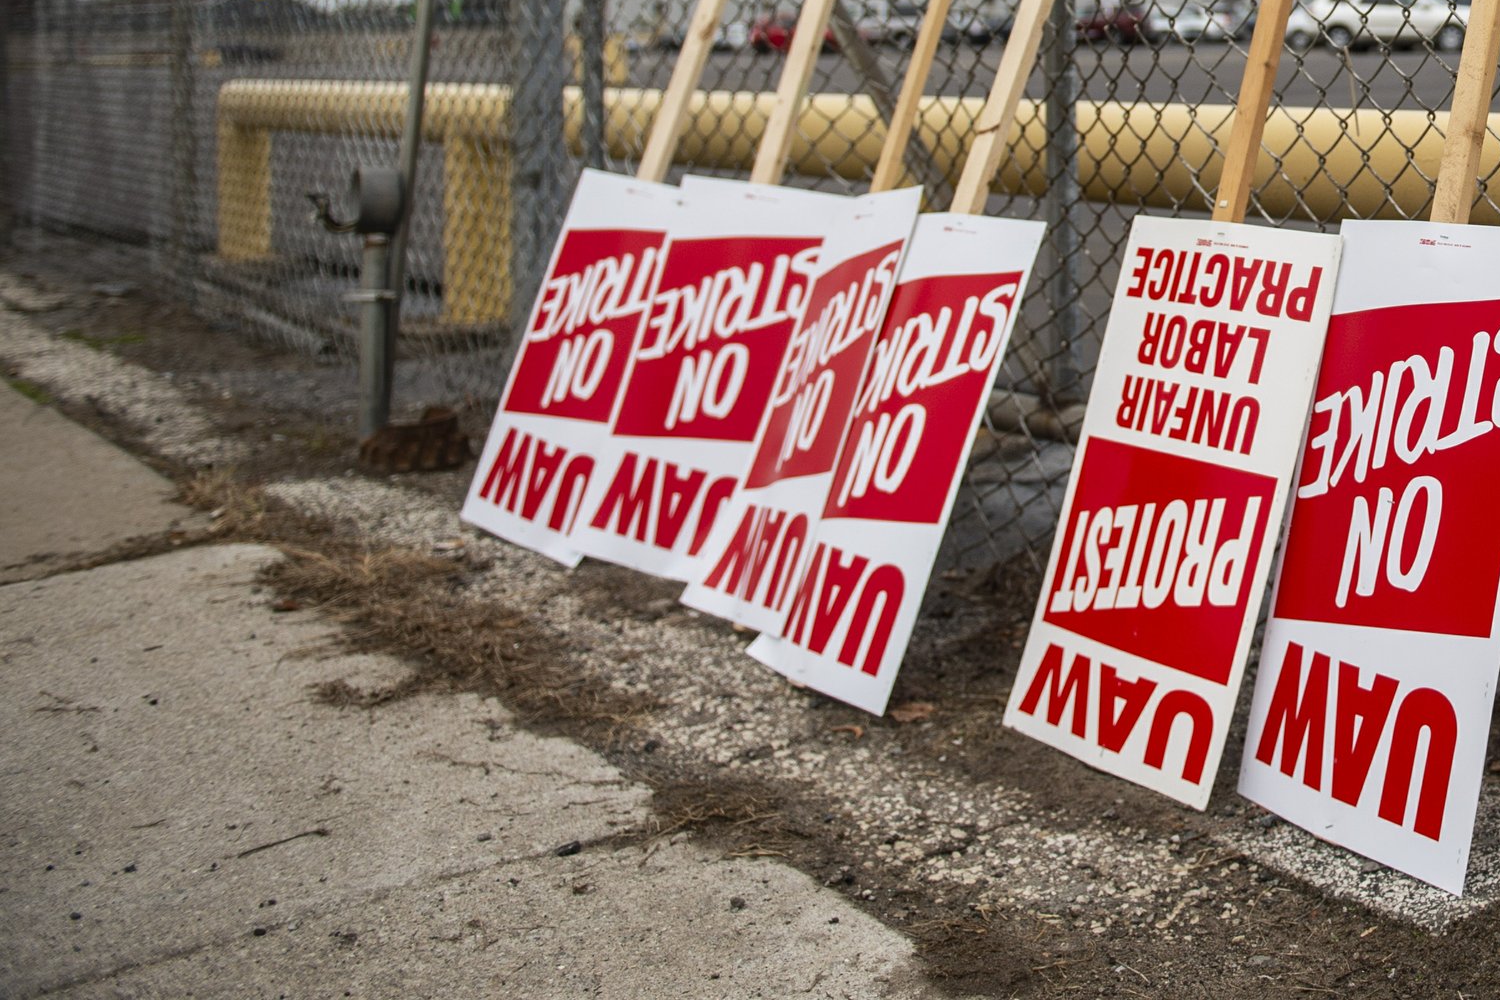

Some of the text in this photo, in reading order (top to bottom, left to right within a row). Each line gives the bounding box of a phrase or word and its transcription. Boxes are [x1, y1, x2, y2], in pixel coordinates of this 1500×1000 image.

[528, 247, 662, 342] TRIKE
[636, 246, 824, 361] STRIKE
[773, 250, 900, 409] STRIKE
[1126, 247, 1323, 323] PRACTICE
[540, 328, 615, 409] ON
[664, 342, 750, 430] ON
[854, 282, 1018, 419] STRIK
[1137, 312, 1272, 385] LABOR
[775, 368, 835, 473] ON
[837, 402, 927, 508] ON
[1116, 374, 1261, 455] UNFAIR
[479, 427, 596, 537] UAW
[703, 504, 808, 612] UAW
[1049, 496, 1263, 614] PROTEST
[1335, 475, 1443, 608] ON
[1018, 642, 1214, 785] UAW
[1255, 640, 1459, 843] UAW
